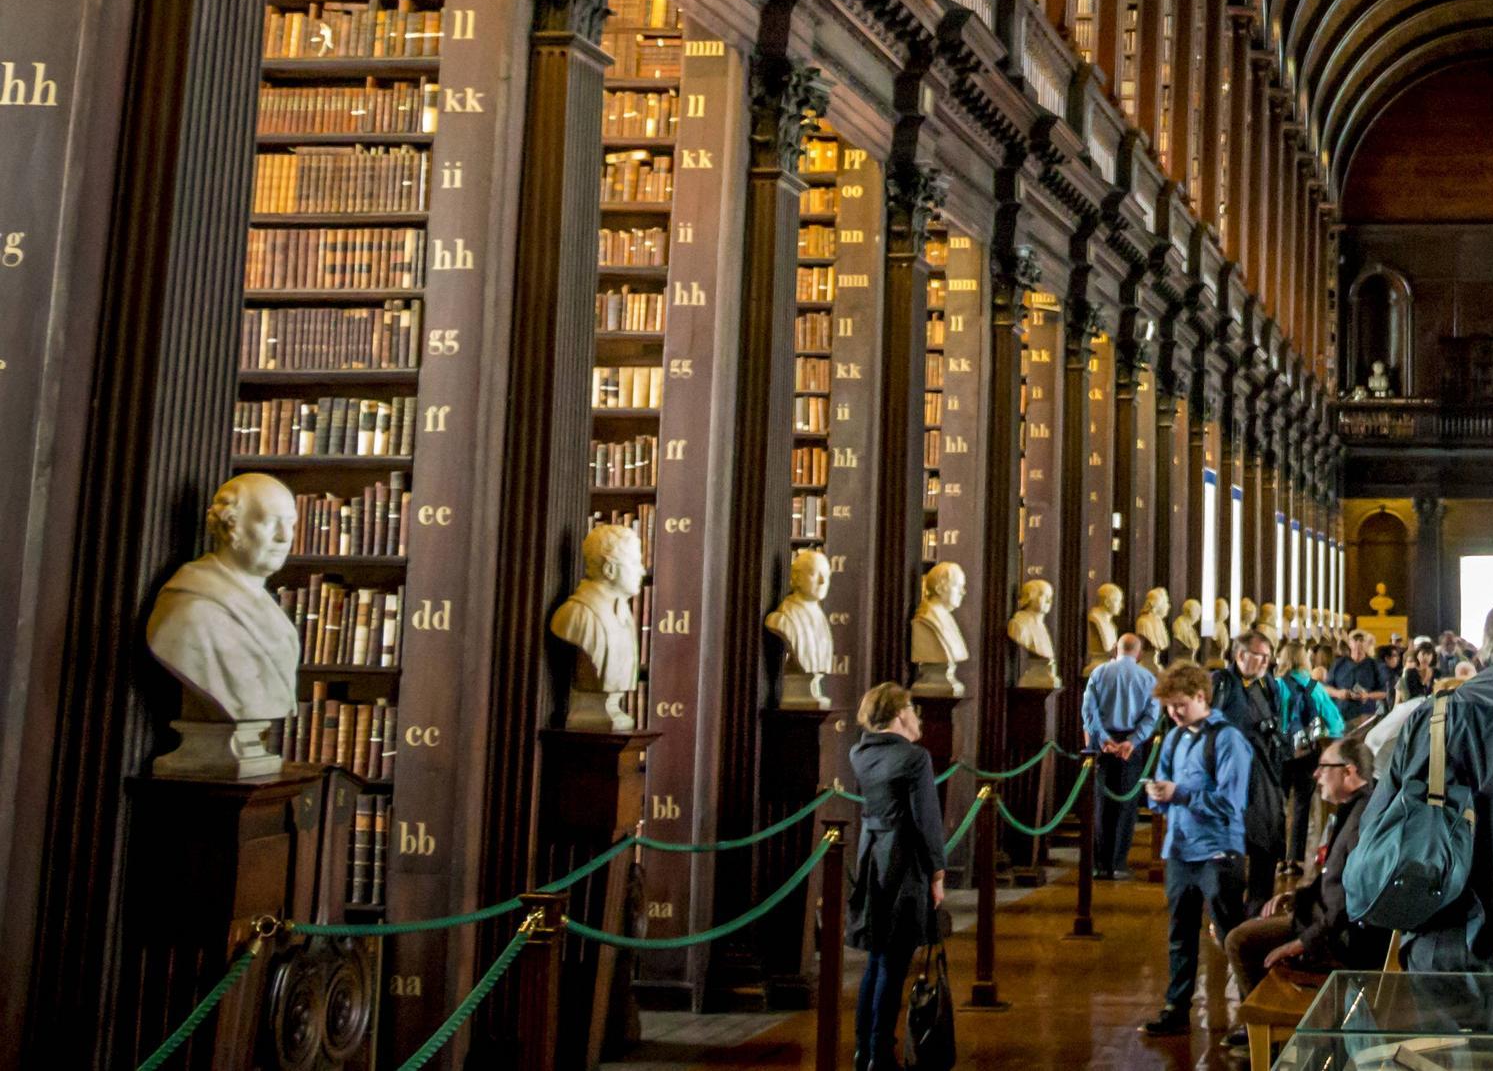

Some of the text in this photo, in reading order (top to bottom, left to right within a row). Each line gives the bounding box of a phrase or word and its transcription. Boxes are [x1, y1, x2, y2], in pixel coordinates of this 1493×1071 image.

[451, 9, 475, 40] ll
[685, 40, 725, 59] mm
[0, 61, 57, 106] hh
[444, 87, 484, 113] kk
[686, 94, 705, 118] ll
[681, 149, 713, 169] kk
[843, 149, 867, 170] pp
[441, 161, 462, 189] ii
[841, 184, 864, 199] oo
[677, 222, 693, 243] ii
[840, 229, 864, 243] nn
[949, 237, 971, 249] nn
[0, 231, 25, 267] g
[431, 238, 473, 271] hh
[837, 274, 869, 288] mm
[948, 278, 977, 291] mm
[673, 281, 706, 306] hh
[838, 317, 853, 337] ll
[949, 314, 964, 332] ll
[428, 329, 460, 356] gg
[669, 359, 693, 379] gg
[836, 362, 862, 379] kk
[948, 357, 971, 372] kk
[836, 403, 850, 421] ii
[947, 393, 960, 411] ii
[423, 405, 451, 433] ff
[665, 439, 687, 461] ff
[944, 435, 968, 453] hh
[832, 447, 858, 468] hh
[417, 505, 452, 526] ee
[664, 517, 691, 534] ee
[943, 529, 960, 545] ff
[411, 599, 451, 631] dd
[658, 609, 690, 634] dd
[829, 613, 849, 625] ee
[656, 701, 684, 718] cc
[404, 725, 440, 747] cc
[651, 794, 681, 820] bb
[398, 821, 436, 856] bb
[647, 901, 673, 918] aa
[391, 975, 422, 997] aa
